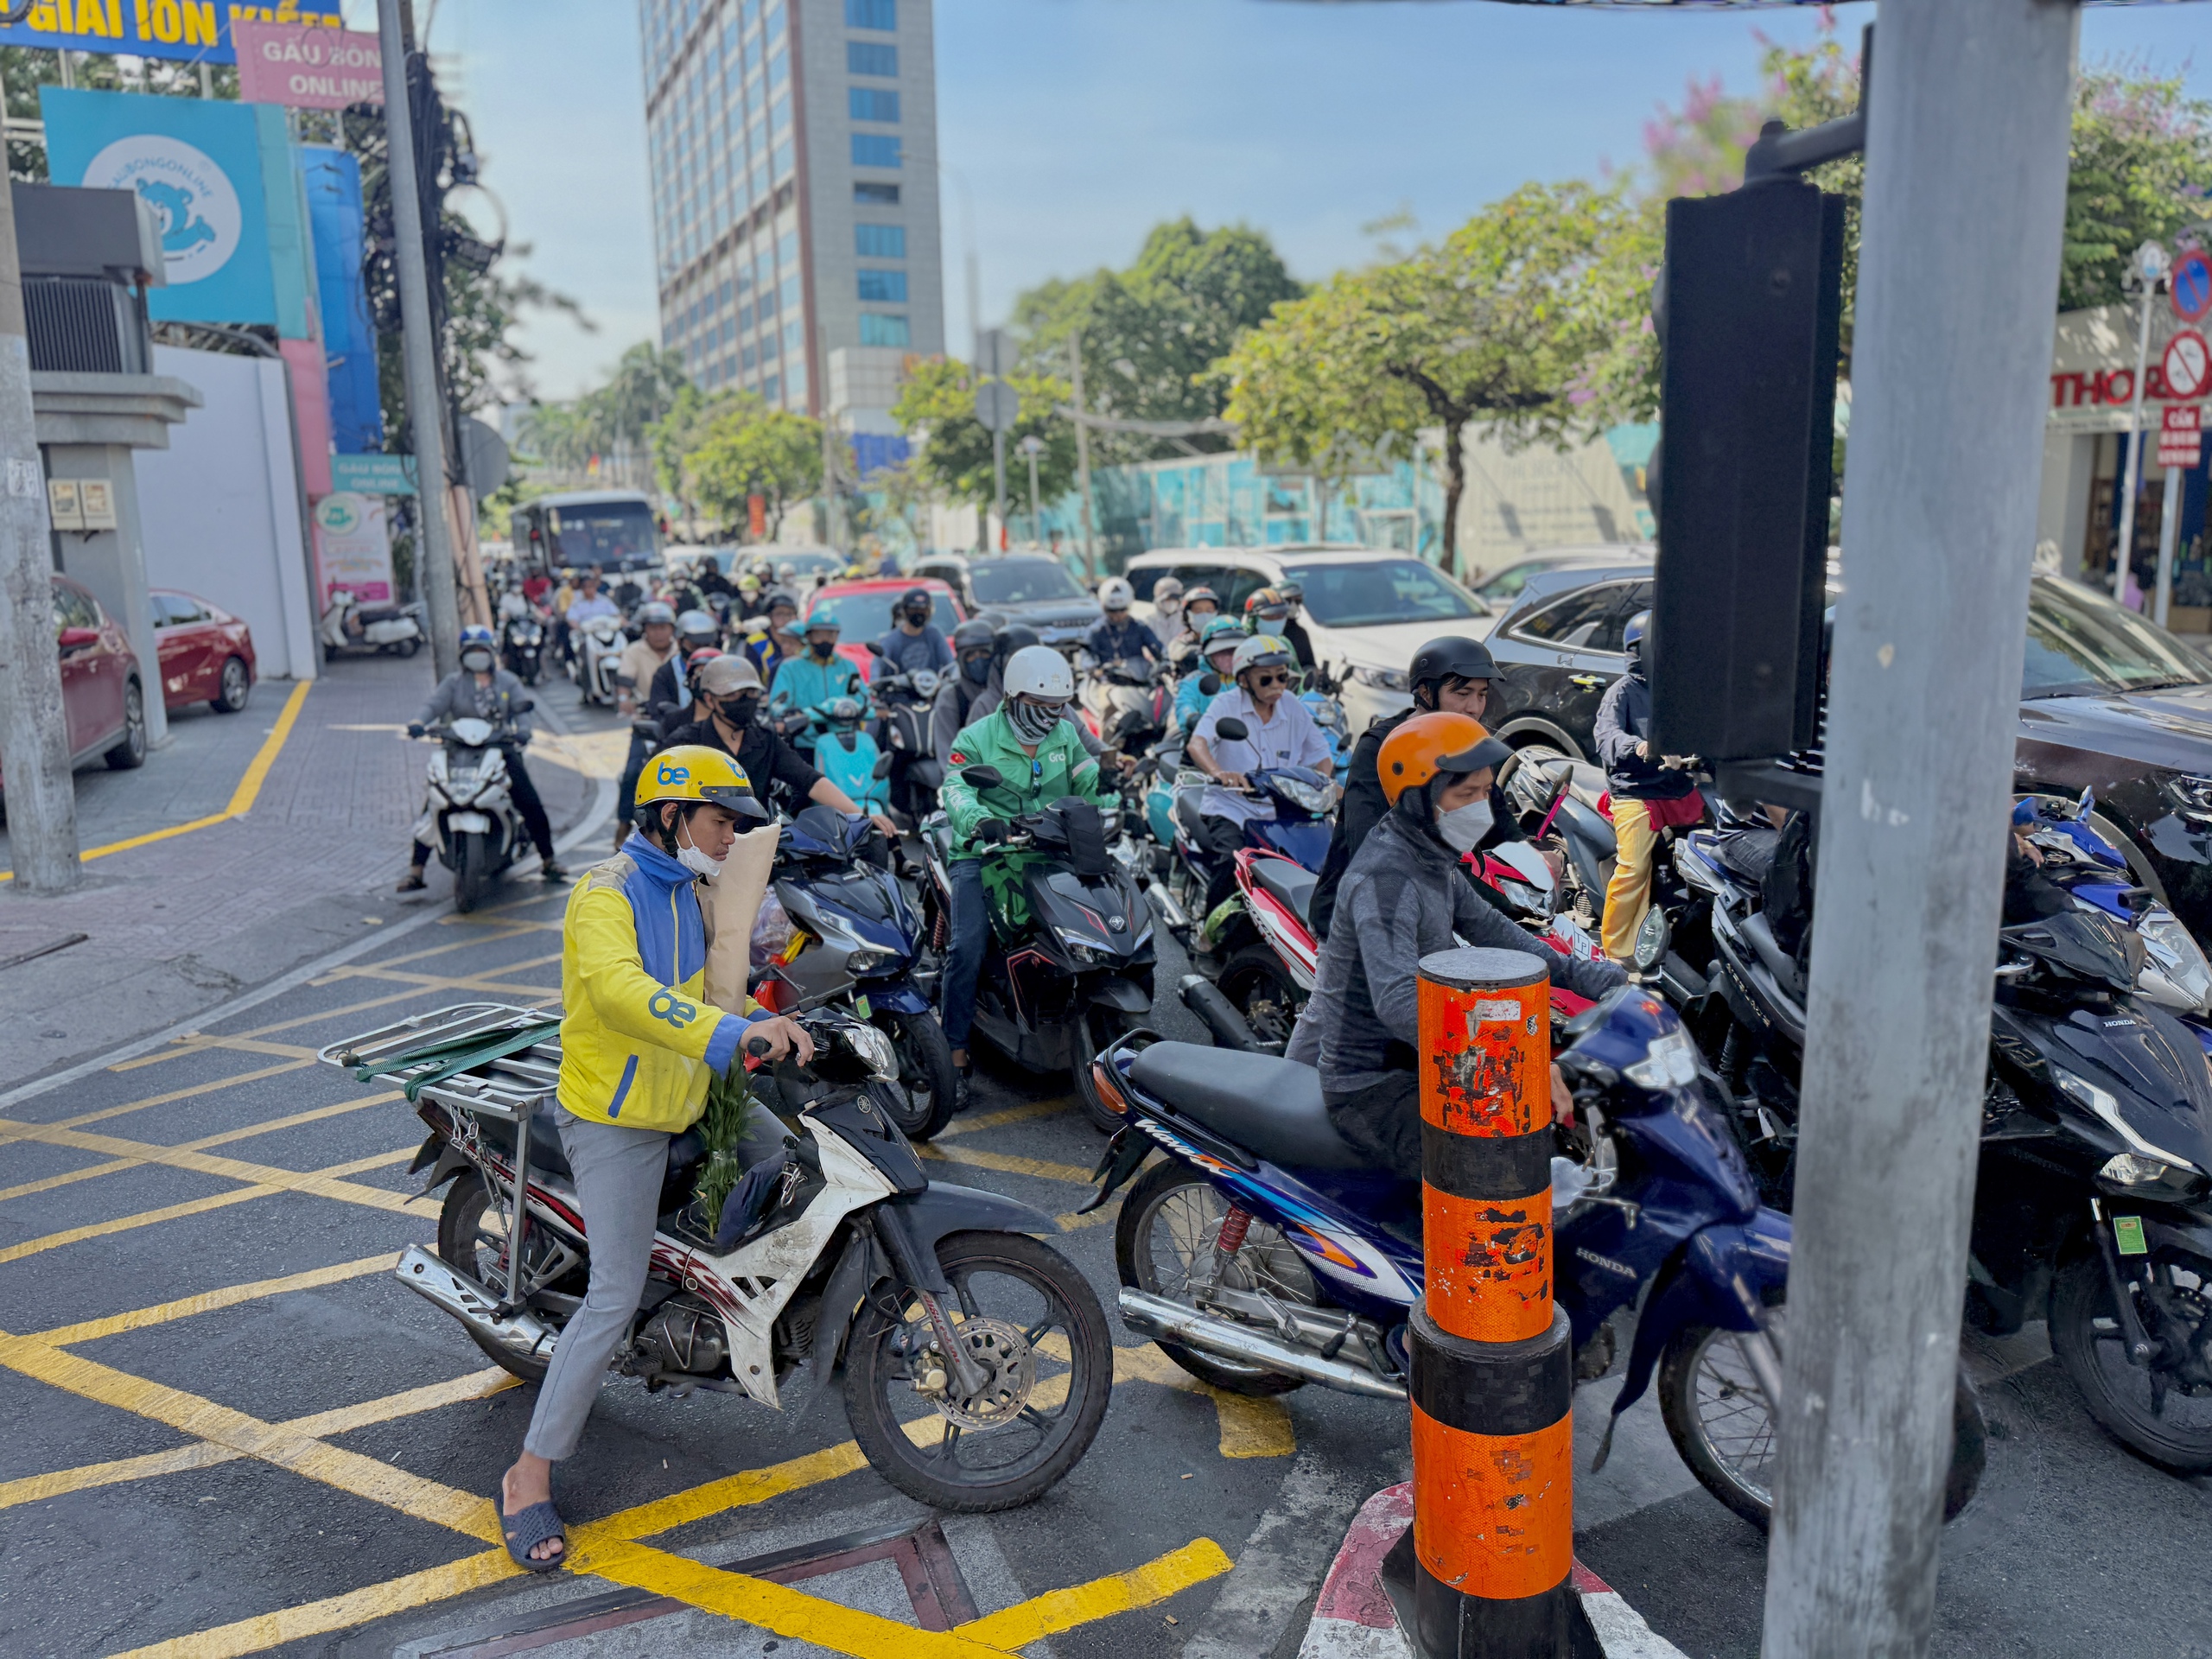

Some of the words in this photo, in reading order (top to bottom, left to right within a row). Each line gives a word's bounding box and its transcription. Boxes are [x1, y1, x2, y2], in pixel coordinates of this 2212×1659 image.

[328, 42, 383, 69] BÔN
[107, 156, 214, 199] AUBONGONLINE
[723, 758, 748, 779] b
[1048, 752, 1067, 763] Gra
[657, 761, 690, 785] be
[648, 986, 697, 1029] be
[2103, 1019, 2137, 1028] HONDA
[1575, 1246, 1637, 1279] HONDA
